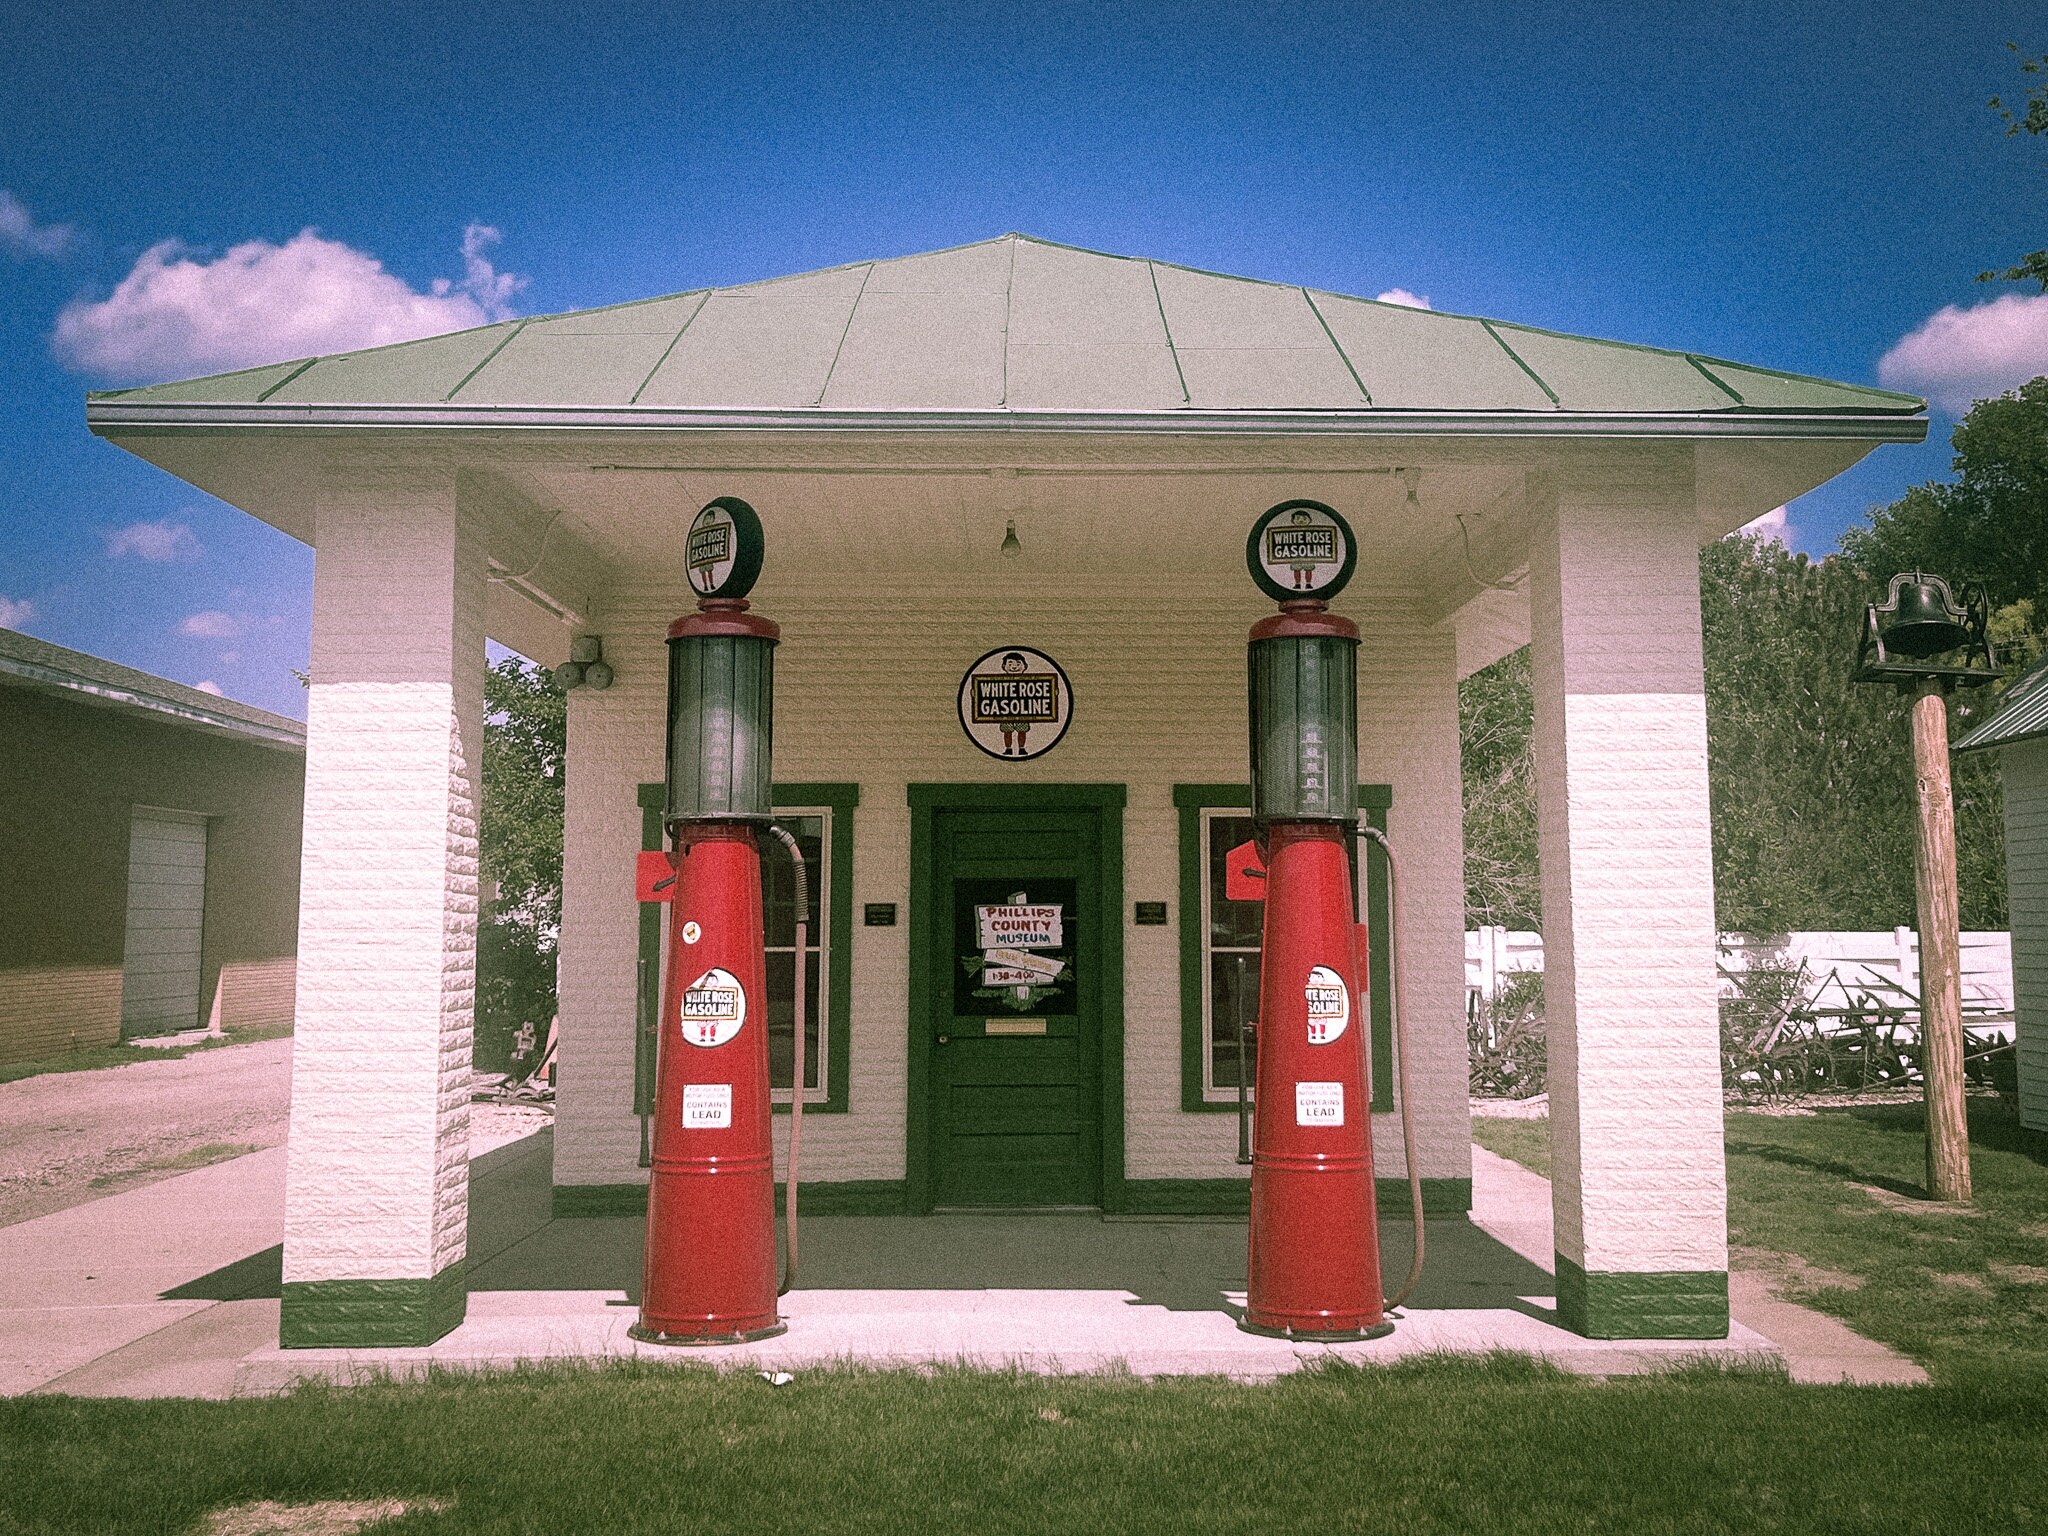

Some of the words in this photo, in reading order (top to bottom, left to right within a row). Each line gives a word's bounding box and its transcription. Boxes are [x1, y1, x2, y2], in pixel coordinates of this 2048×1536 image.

[708, 529, 726, 543] ROSE
[1273, 532, 1304, 544] WHITE
[1305, 532, 1331, 544] ROSE
[692, 542, 725, 562] GASOLINE
[1274, 544, 1331, 558] GASOLINE
[980, 682, 1017, 698] WHITE
[1019, 682, 1050, 698] ROSE
[980, 699, 1050, 715] GASOLINE
[985, 907, 1055, 918] PHILLIPS
[991, 920, 1051, 932] COUNTY
[996, 933, 1051, 944] MUSEUM
[685, 990, 711, 1003] WHITE
[712, 991, 734, 1003] ROSE
[1319, 989, 1339, 1001] ROSE
[685, 1003, 734, 1016] GASOLINE
[686, 1101, 728, 1109] CONTAINS
[1300, 1098, 1340, 1106] CONTAINS
[692, 1110, 721, 1119] LEAD
[1306, 1107, 1335, 1116] LEAD
